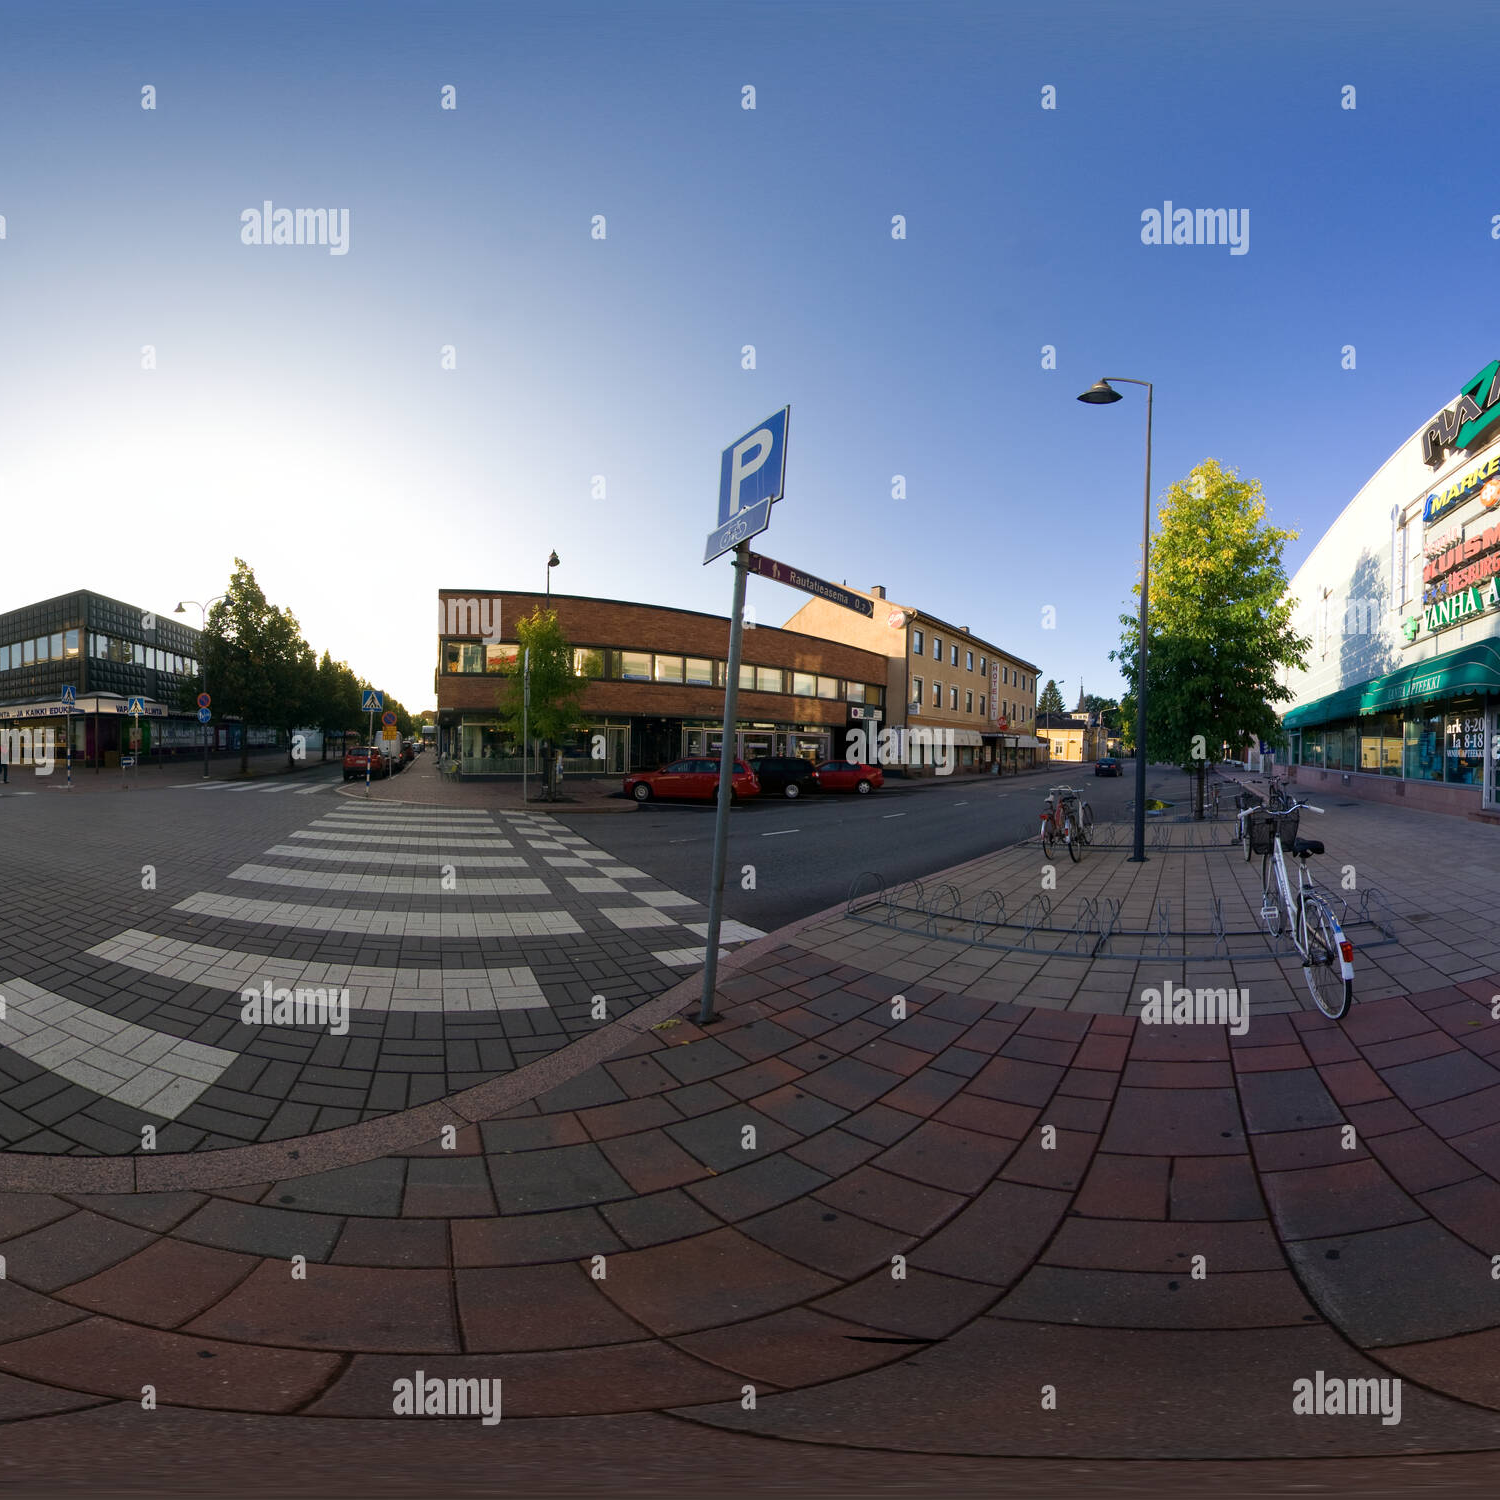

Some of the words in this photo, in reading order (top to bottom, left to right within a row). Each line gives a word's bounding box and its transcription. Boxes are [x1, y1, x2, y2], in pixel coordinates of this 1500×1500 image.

[1422, 360, 1500, 464] PLAZ
[729, 428, 774, 517] P
[789, 571, 848, 605] Rautatieasema
[1423, 587, 1478, 631] VANHA
[991, 665, 999, 718] HOTELLI
[1447, 718, 1462, 734] ark
[1464, 717, 1485, 732] 8-20
[1464, 733, 1484, 748] 8-18
